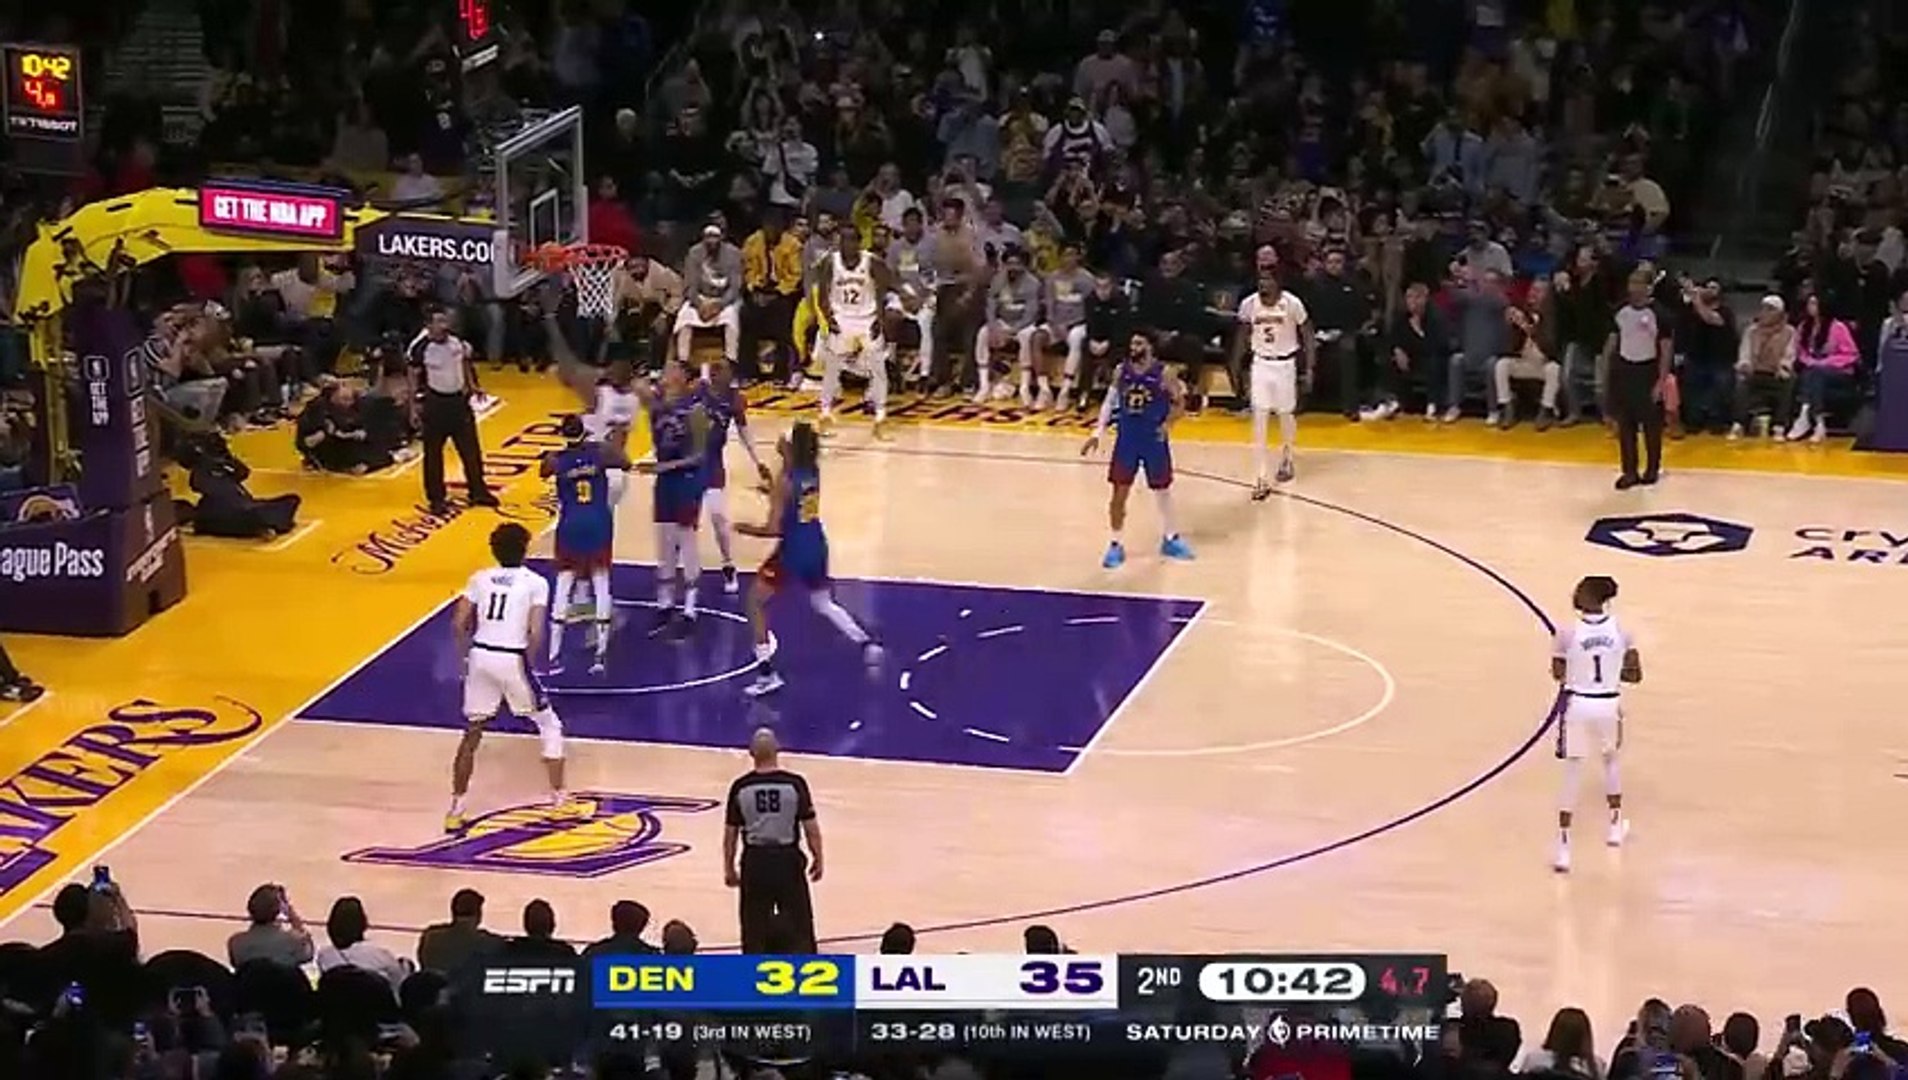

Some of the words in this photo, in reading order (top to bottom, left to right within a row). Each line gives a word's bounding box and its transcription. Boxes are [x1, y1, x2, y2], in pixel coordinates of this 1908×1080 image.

[214, 195, 239, 219] GET
[242, 198, 267, 222] THE
[270, 201, 297, 224] NBA
[299, 203, 326, 227] APP
[378, 233, 494, 263] LAKERS.CO
[1, 547, 51, 583] ague
[53, 541, 105, 578] Pass
[486, 591, 508, 621] 11
[1593, 654, 1604, 684] 1
